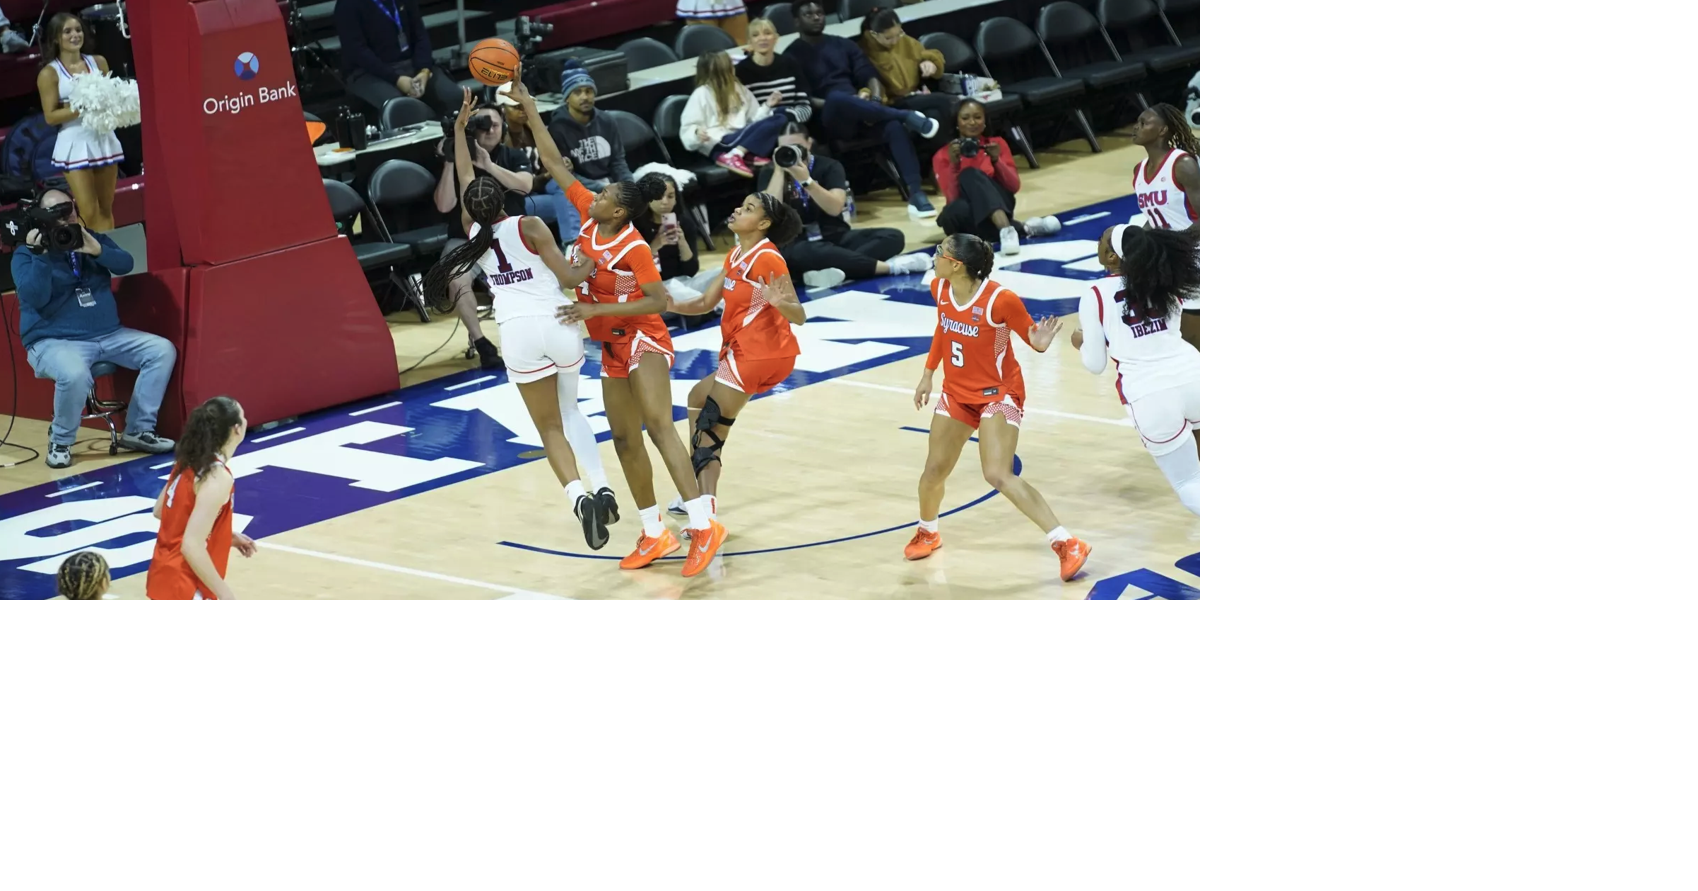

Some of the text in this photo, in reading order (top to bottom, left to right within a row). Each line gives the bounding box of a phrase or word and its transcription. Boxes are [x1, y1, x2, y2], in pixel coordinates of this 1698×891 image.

[480, 67, 508, 80] ELITE
[203, 80, 297, 115] Origin Bank
[1138, 189, 1168, 209] SMU
[1147, 207, 1173, 229] 11
[488, 238, 513, 274] 1
[489, 267, 534, 286] THOMPSON
[940, 312, 980, 338] Syracuse
[951, 340, 964, 368] 5
